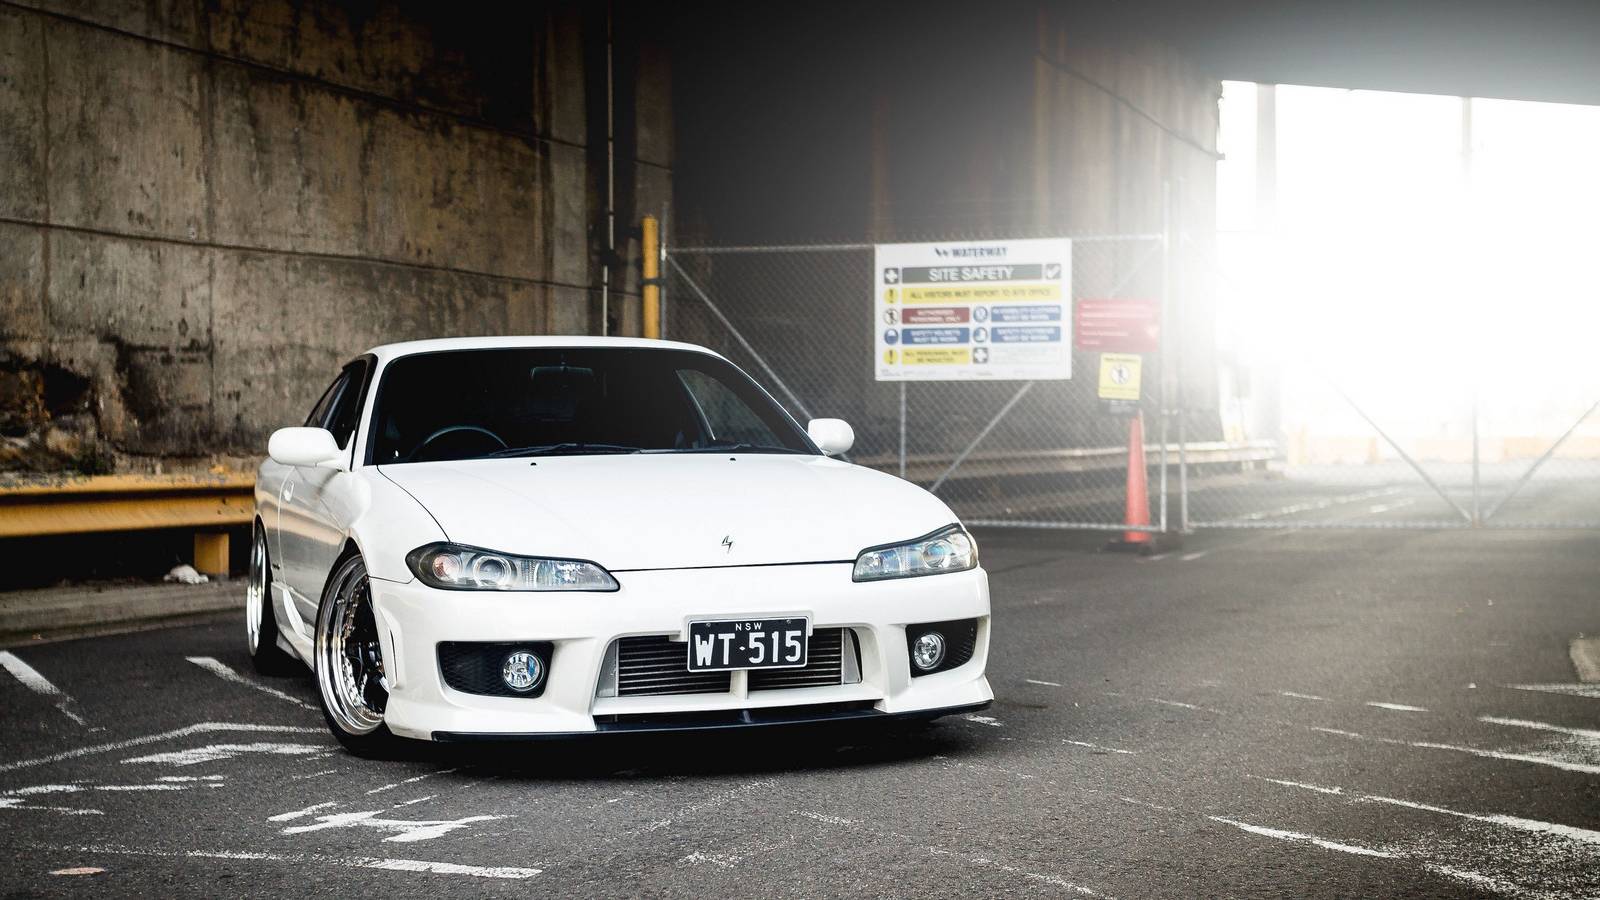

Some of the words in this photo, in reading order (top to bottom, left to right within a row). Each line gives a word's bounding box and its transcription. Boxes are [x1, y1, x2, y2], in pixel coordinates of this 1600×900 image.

[928, 267, 960, 281] SITE
[961, 266, 1015, 281] SAFETY
[735, 622, 762, 631] NSW
